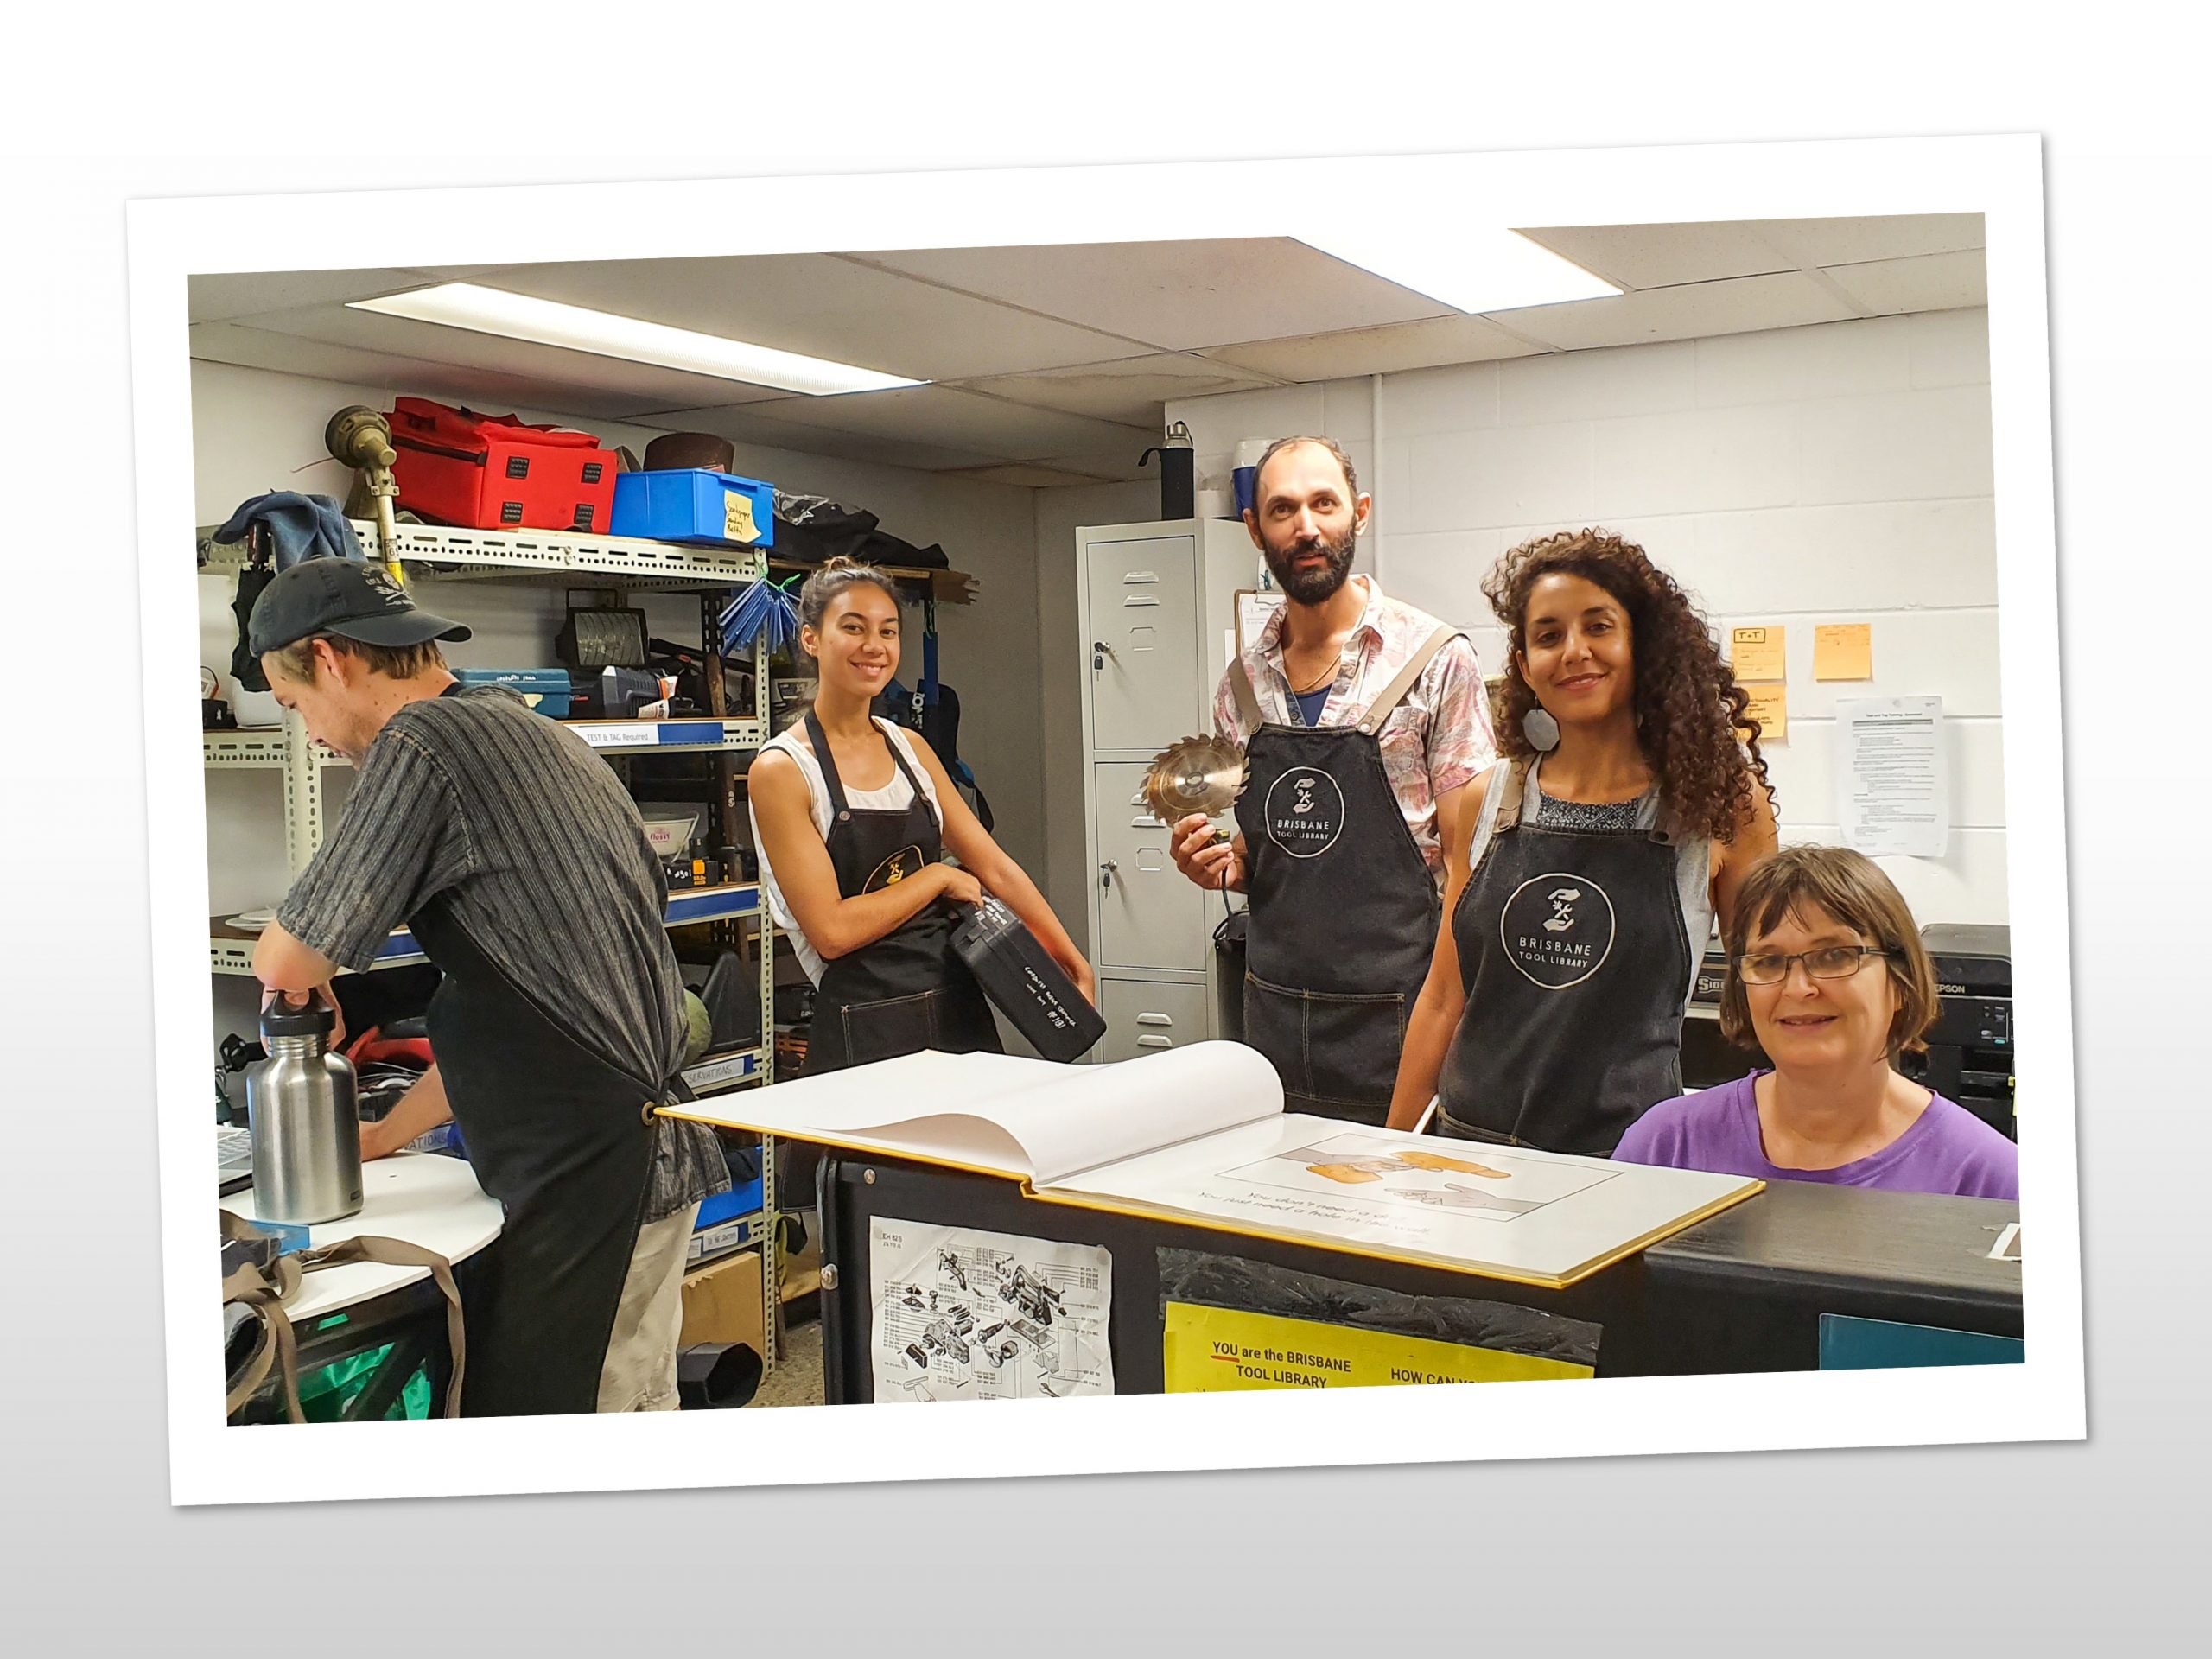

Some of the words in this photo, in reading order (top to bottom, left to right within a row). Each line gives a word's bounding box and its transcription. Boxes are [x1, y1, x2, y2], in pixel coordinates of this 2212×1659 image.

[587, 734, 601, 742] TEST
[609, 733, 621, 741] TAG
[623, 733, 649, 741] Required
[1277, 819, 1330, 830] BRISBANE
[1519, 936, 1592, 957] BRISBANE
[1519, 951, 1546, 963] TOOL
[1550, 956, 1588, 968] LIBRARY
[1935, 983, 1966, 994] EPSON
[1212, 1341, 1239, 1356] YOU
[1242, 1348, 1262, 1359] are
[1263, 1349, 1284, 1362] the
[1287, 1351, 1352, 1373] BRISBANE
[1236, 1365, 1271, 1381] TOOL
[1274, 1370, 1328, 1389] LIBRARY
[1391, 1367, 1423, 1384] HOW
[1427, 1374, 1455, 1384] CAN
